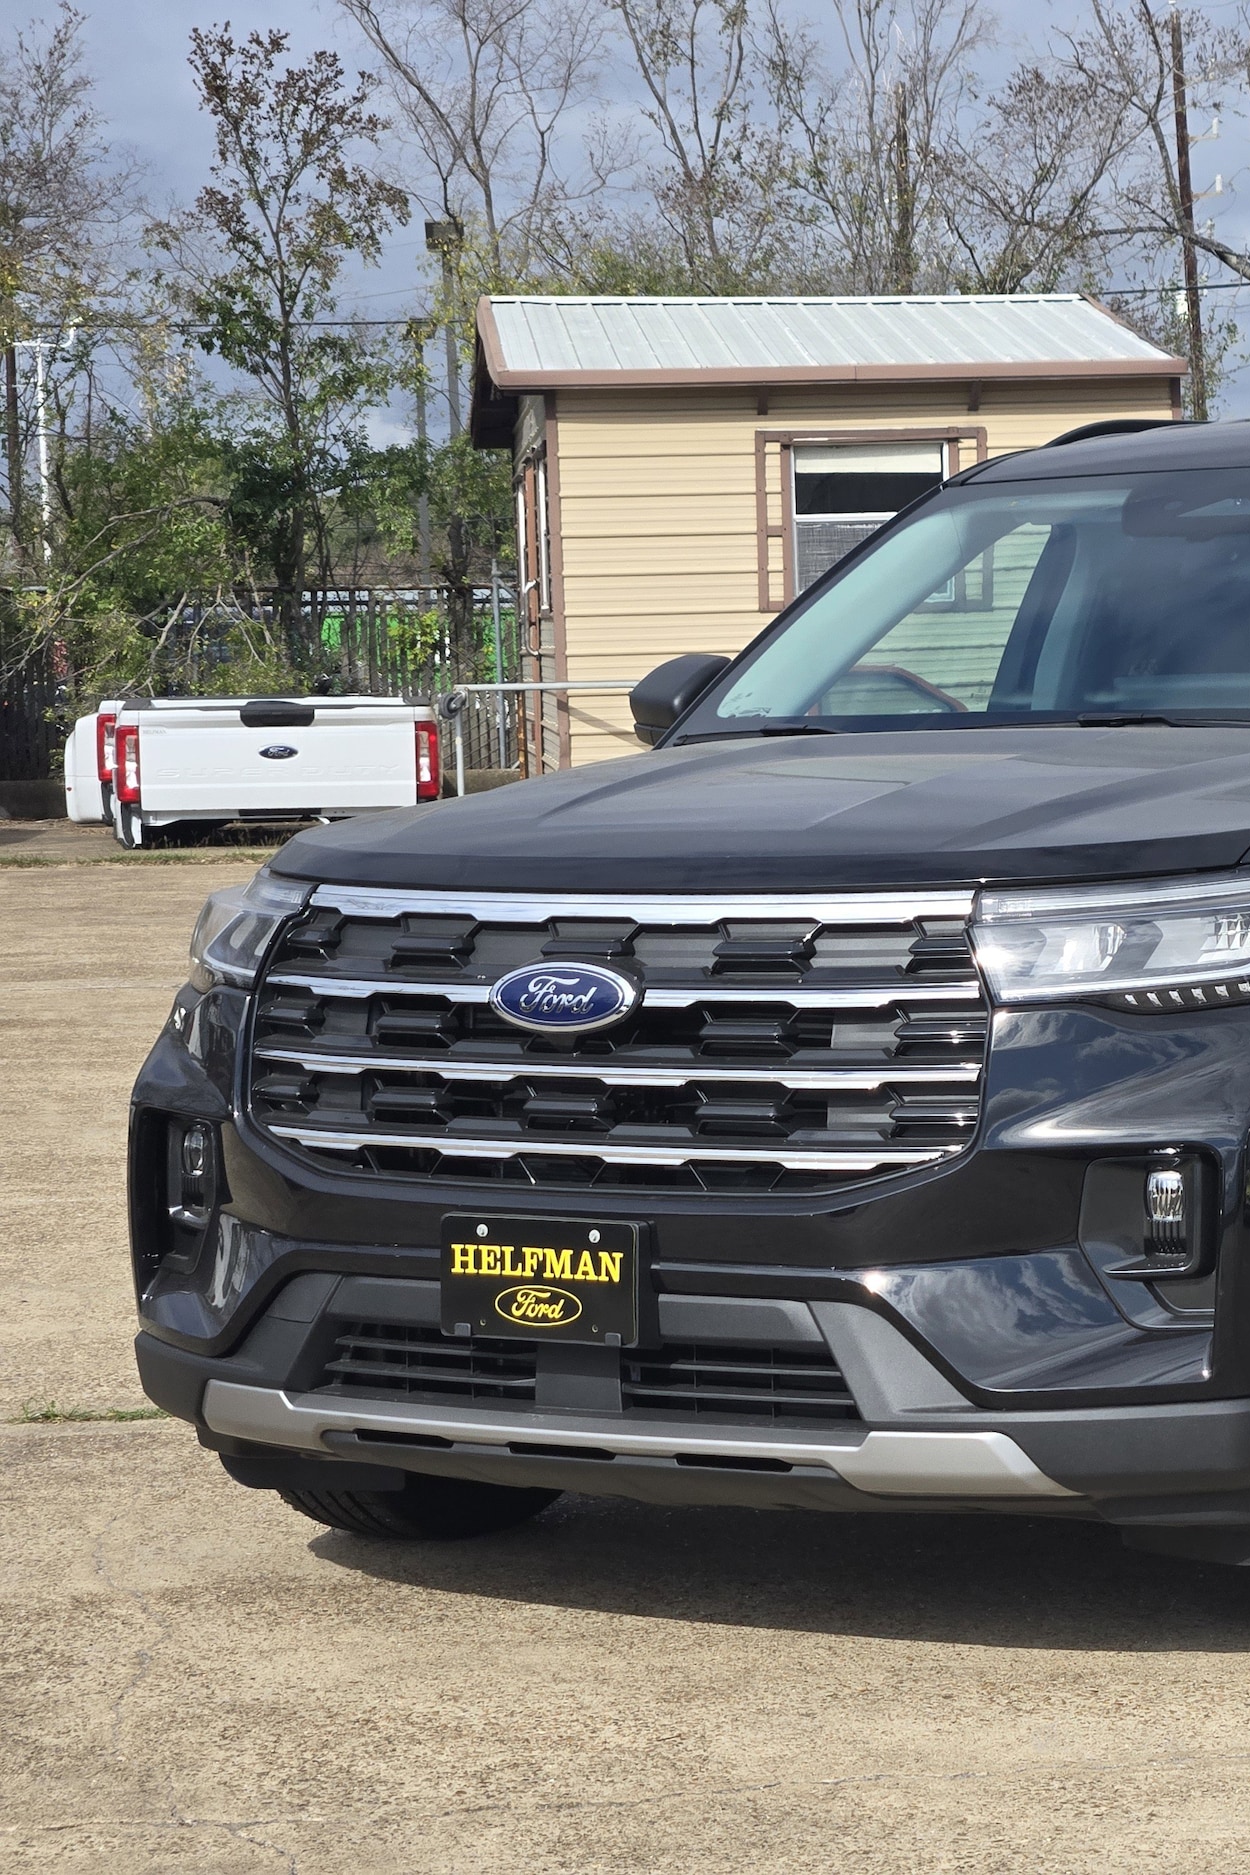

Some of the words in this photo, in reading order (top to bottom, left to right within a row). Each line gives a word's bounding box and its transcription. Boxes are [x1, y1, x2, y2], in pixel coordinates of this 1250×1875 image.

[156, 766, 290, 778] SUPER
[300, 764, 401, 777] DUTY
[519, 975, 598, 1014] Ford
[451, 1244, 624, 1282] HELFMAN
[511, 1289, 566, 1319] Ford
